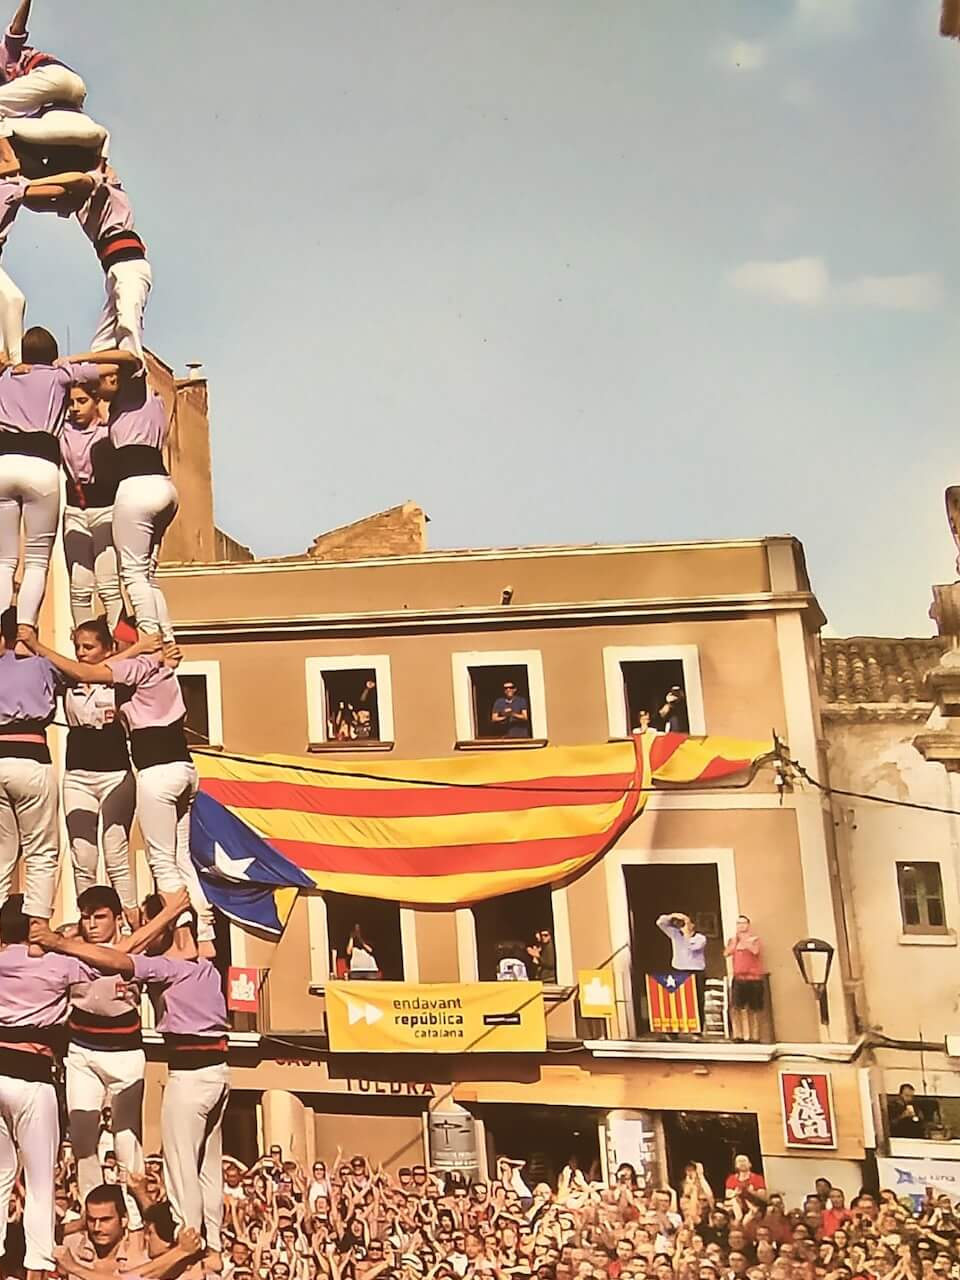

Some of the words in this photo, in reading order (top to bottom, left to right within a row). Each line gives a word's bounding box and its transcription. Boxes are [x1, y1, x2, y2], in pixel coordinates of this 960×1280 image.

[393, 997, 462, 1010] endavant
[394, 1012, 464, 1028] república
[414, 1029, 464, 1038] catalana
